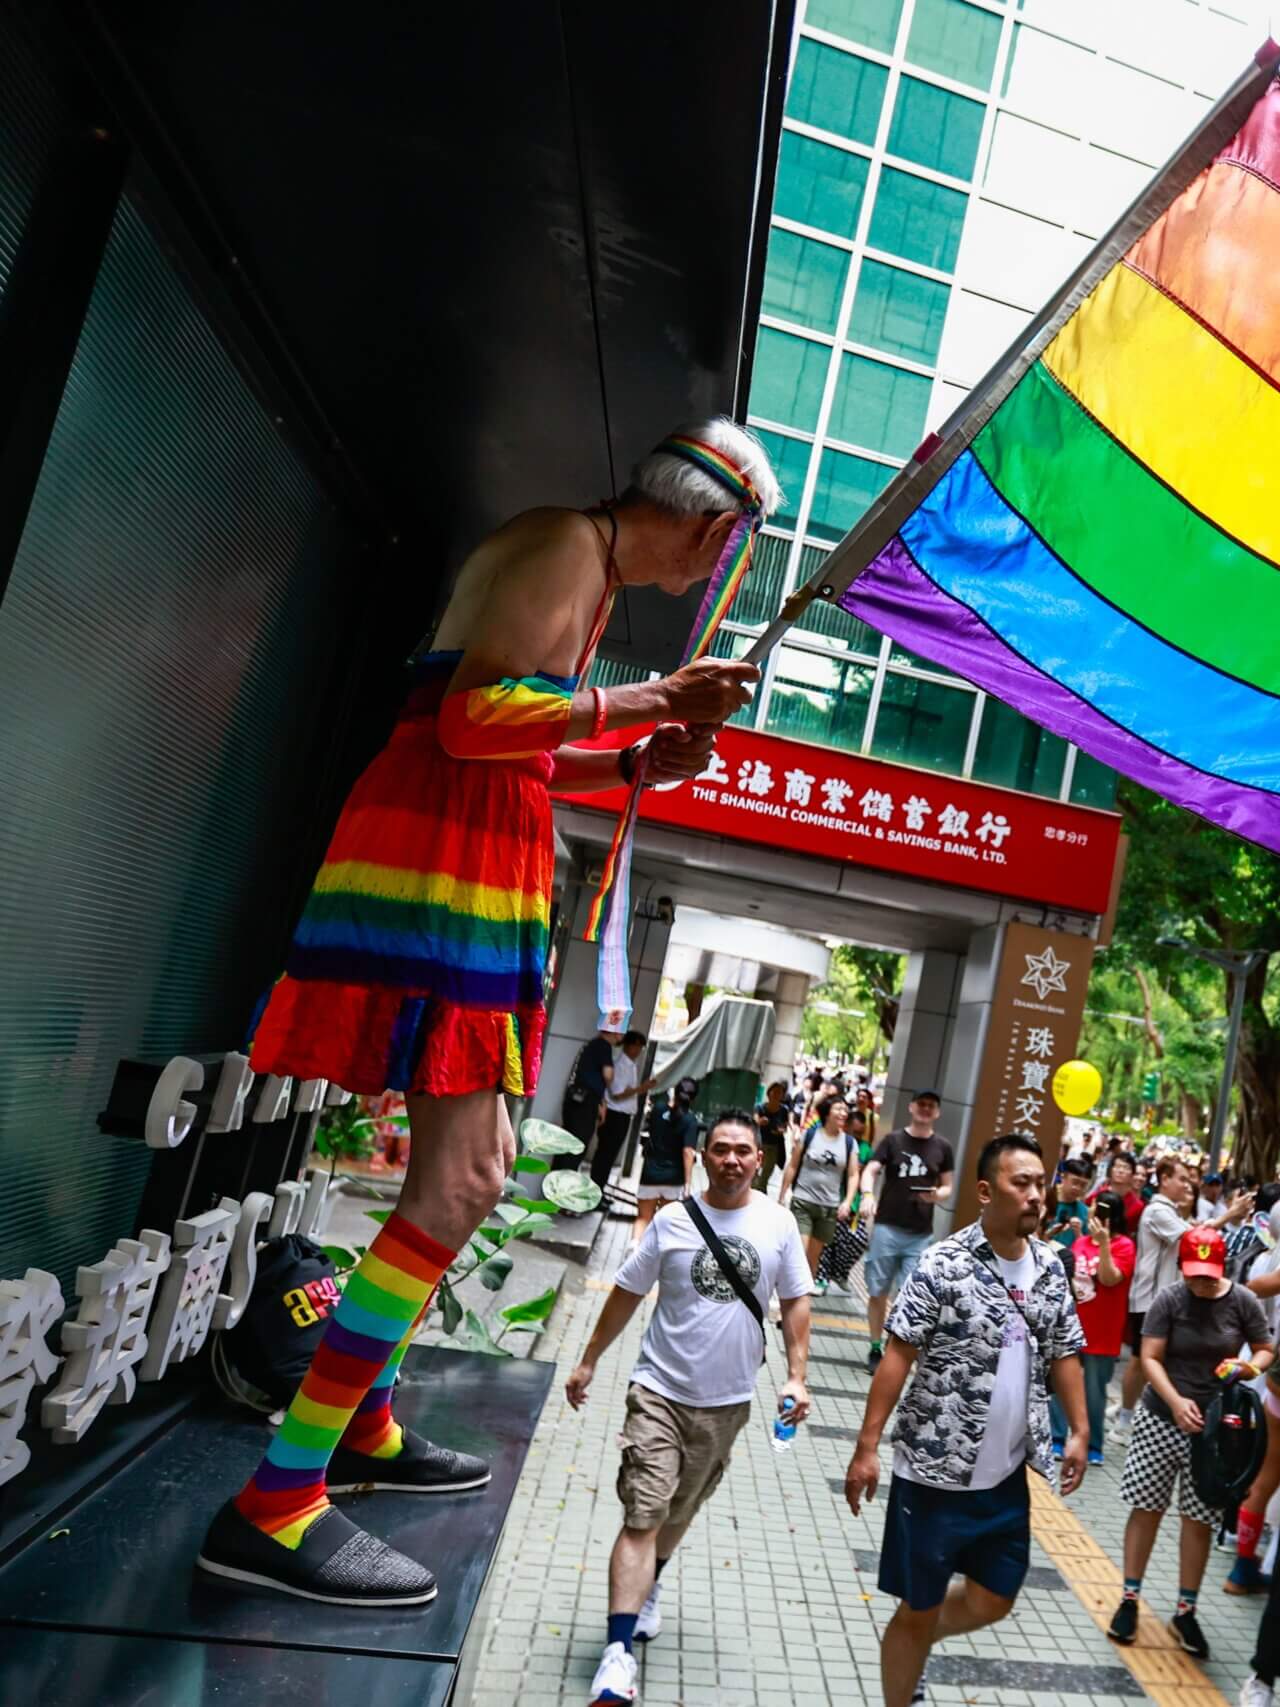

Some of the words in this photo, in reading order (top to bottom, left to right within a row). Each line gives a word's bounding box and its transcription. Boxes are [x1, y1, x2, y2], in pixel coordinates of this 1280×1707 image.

[692, 786, 717, 802] THE
[719, 791, 787, 820] SHANGHAI
[790, 809, 872, 837] COMMERCIAL
[874, 826, 884, 839] &
[887, 829, 941, 852] SAVINGS
[943, 842, 979, 861] BANK,
[982, 849, 1008, 865] LTD.
[694, 752, 1011, 847] 上海商業儲蓄銀行
